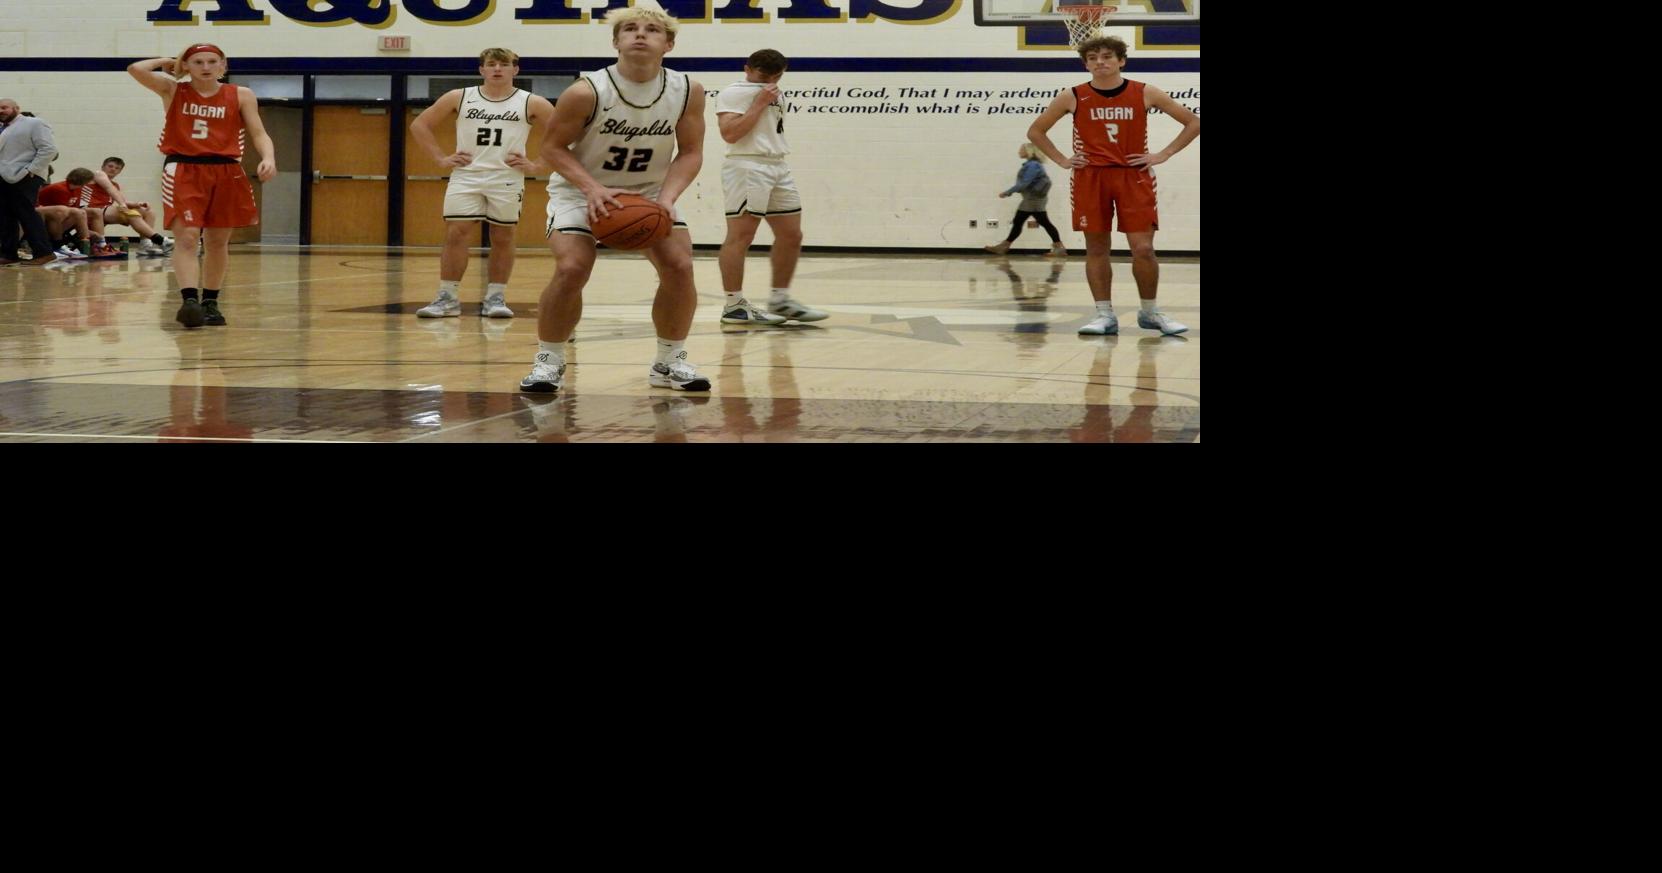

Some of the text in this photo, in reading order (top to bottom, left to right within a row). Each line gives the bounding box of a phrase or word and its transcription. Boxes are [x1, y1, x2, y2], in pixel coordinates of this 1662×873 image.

[384, 37, 405, 48] EXIT
[783, 87, 1066, 101] erciful God, That I may ardent
[182, 102, 226, 119] LOGAN
[465, 103, 521, 124] Blugolds
[807, 102, 909, 114] accomplish
[916, 102, 960, 113] what
[967, 102, 981, 113] is
[1090, 106, 1134, 121] LOGAN
[191, 119, 209, 140] 5
[476, 127, 503, 147] 21
[599, 118, 674, 142] Blugolds
[1104, 123, 1119, 143] 2
[602, 145, 653, 172] 32
